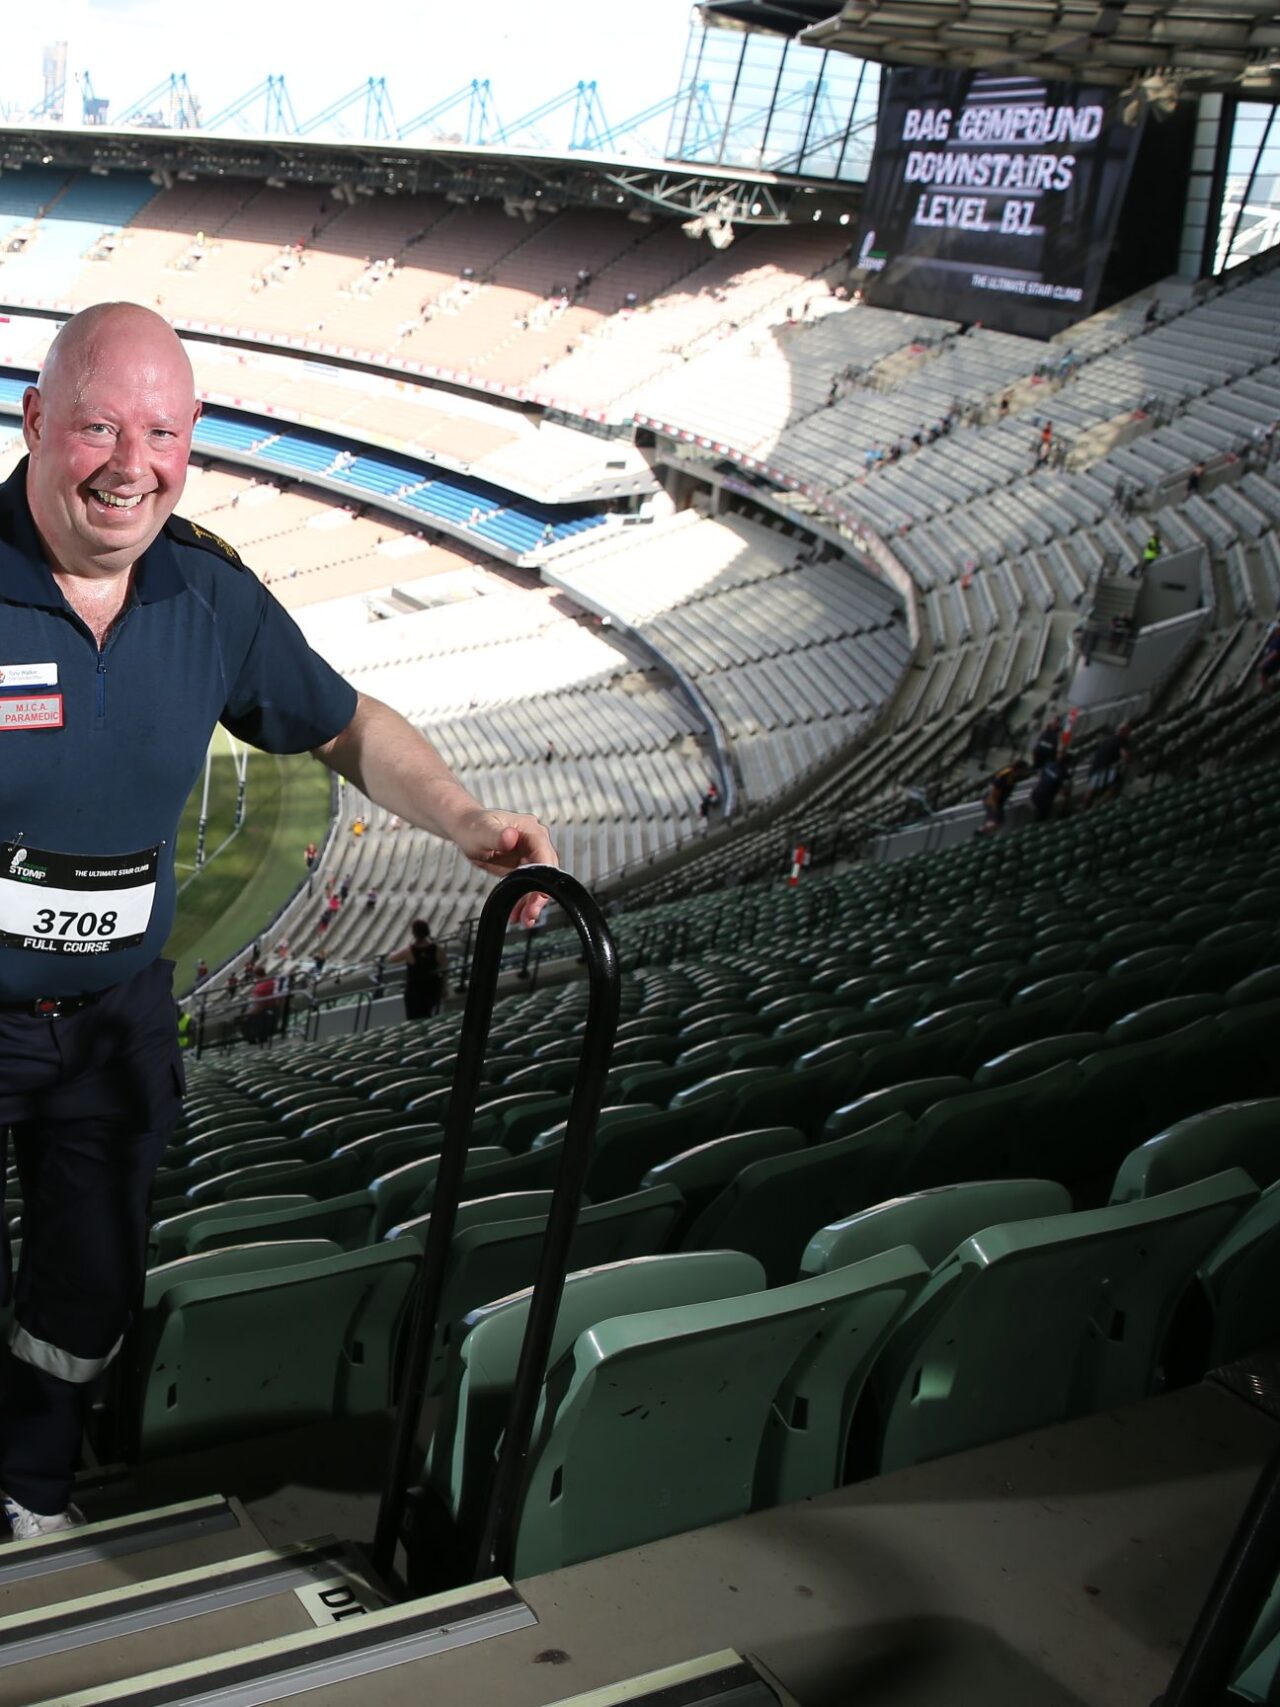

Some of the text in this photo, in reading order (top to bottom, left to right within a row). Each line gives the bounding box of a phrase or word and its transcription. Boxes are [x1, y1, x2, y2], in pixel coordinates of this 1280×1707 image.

[902, 105, 1104, 142] BAG COMPOUND
[904, 151, 1076, 190] DOWNSTAIRS
[914, 194, 1036, 236] LEVEL B1
[971, 274, 987, 287] THE
[987, 277, 1026, 294] ULTIMATE
[4, 711, 59, 723] PARAMEDIC
[9, 865, 46, 880] STOMP
[89, 869, 118, 877] ULTIMATE
[118, 867, 135, 876] STAIR
[33, 909, 118, 937] 3708
[23, 937, 111, 953] FULL COURSE
